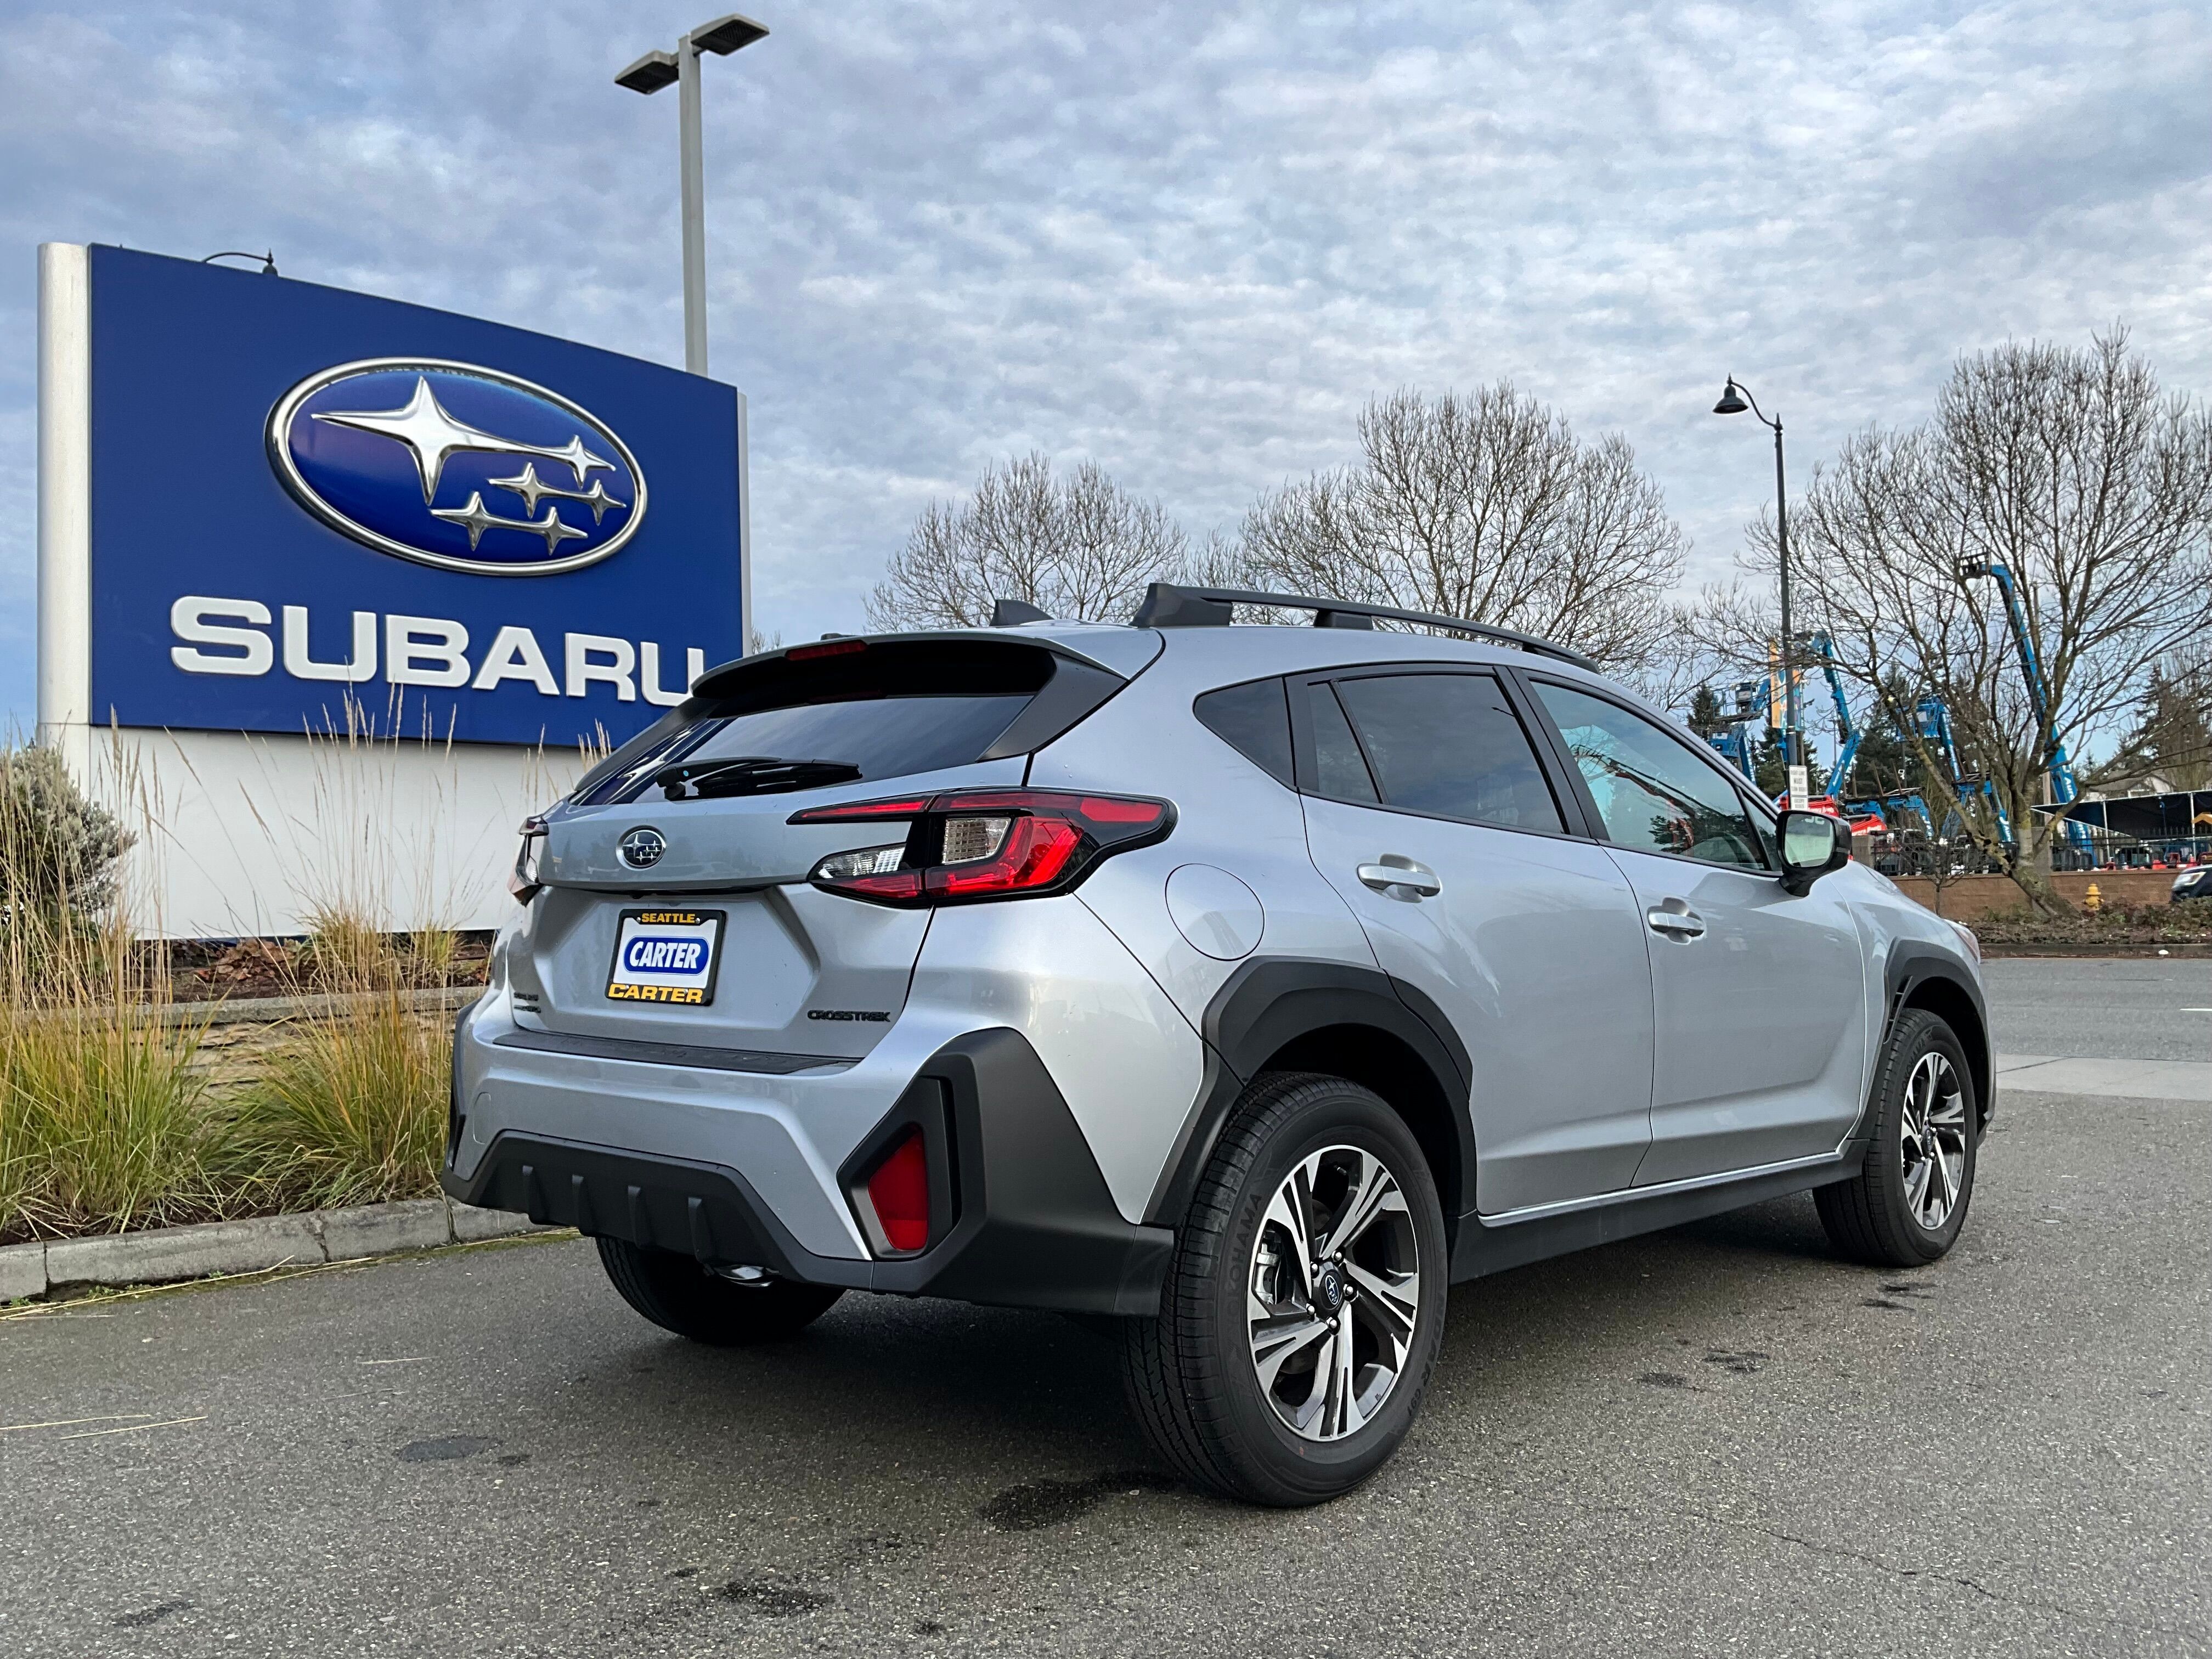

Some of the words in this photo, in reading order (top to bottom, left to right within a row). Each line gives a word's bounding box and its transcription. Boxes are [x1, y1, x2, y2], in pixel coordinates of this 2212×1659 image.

[171, 595, 704, 707] SUBARU
[641, 912, 696, 924] SEATTLE
[629, 941, 701, 969] CARTER
[608, 983, 703, 1004] CARTER
[807, 1009, 891, 1022] CROSSTREK
